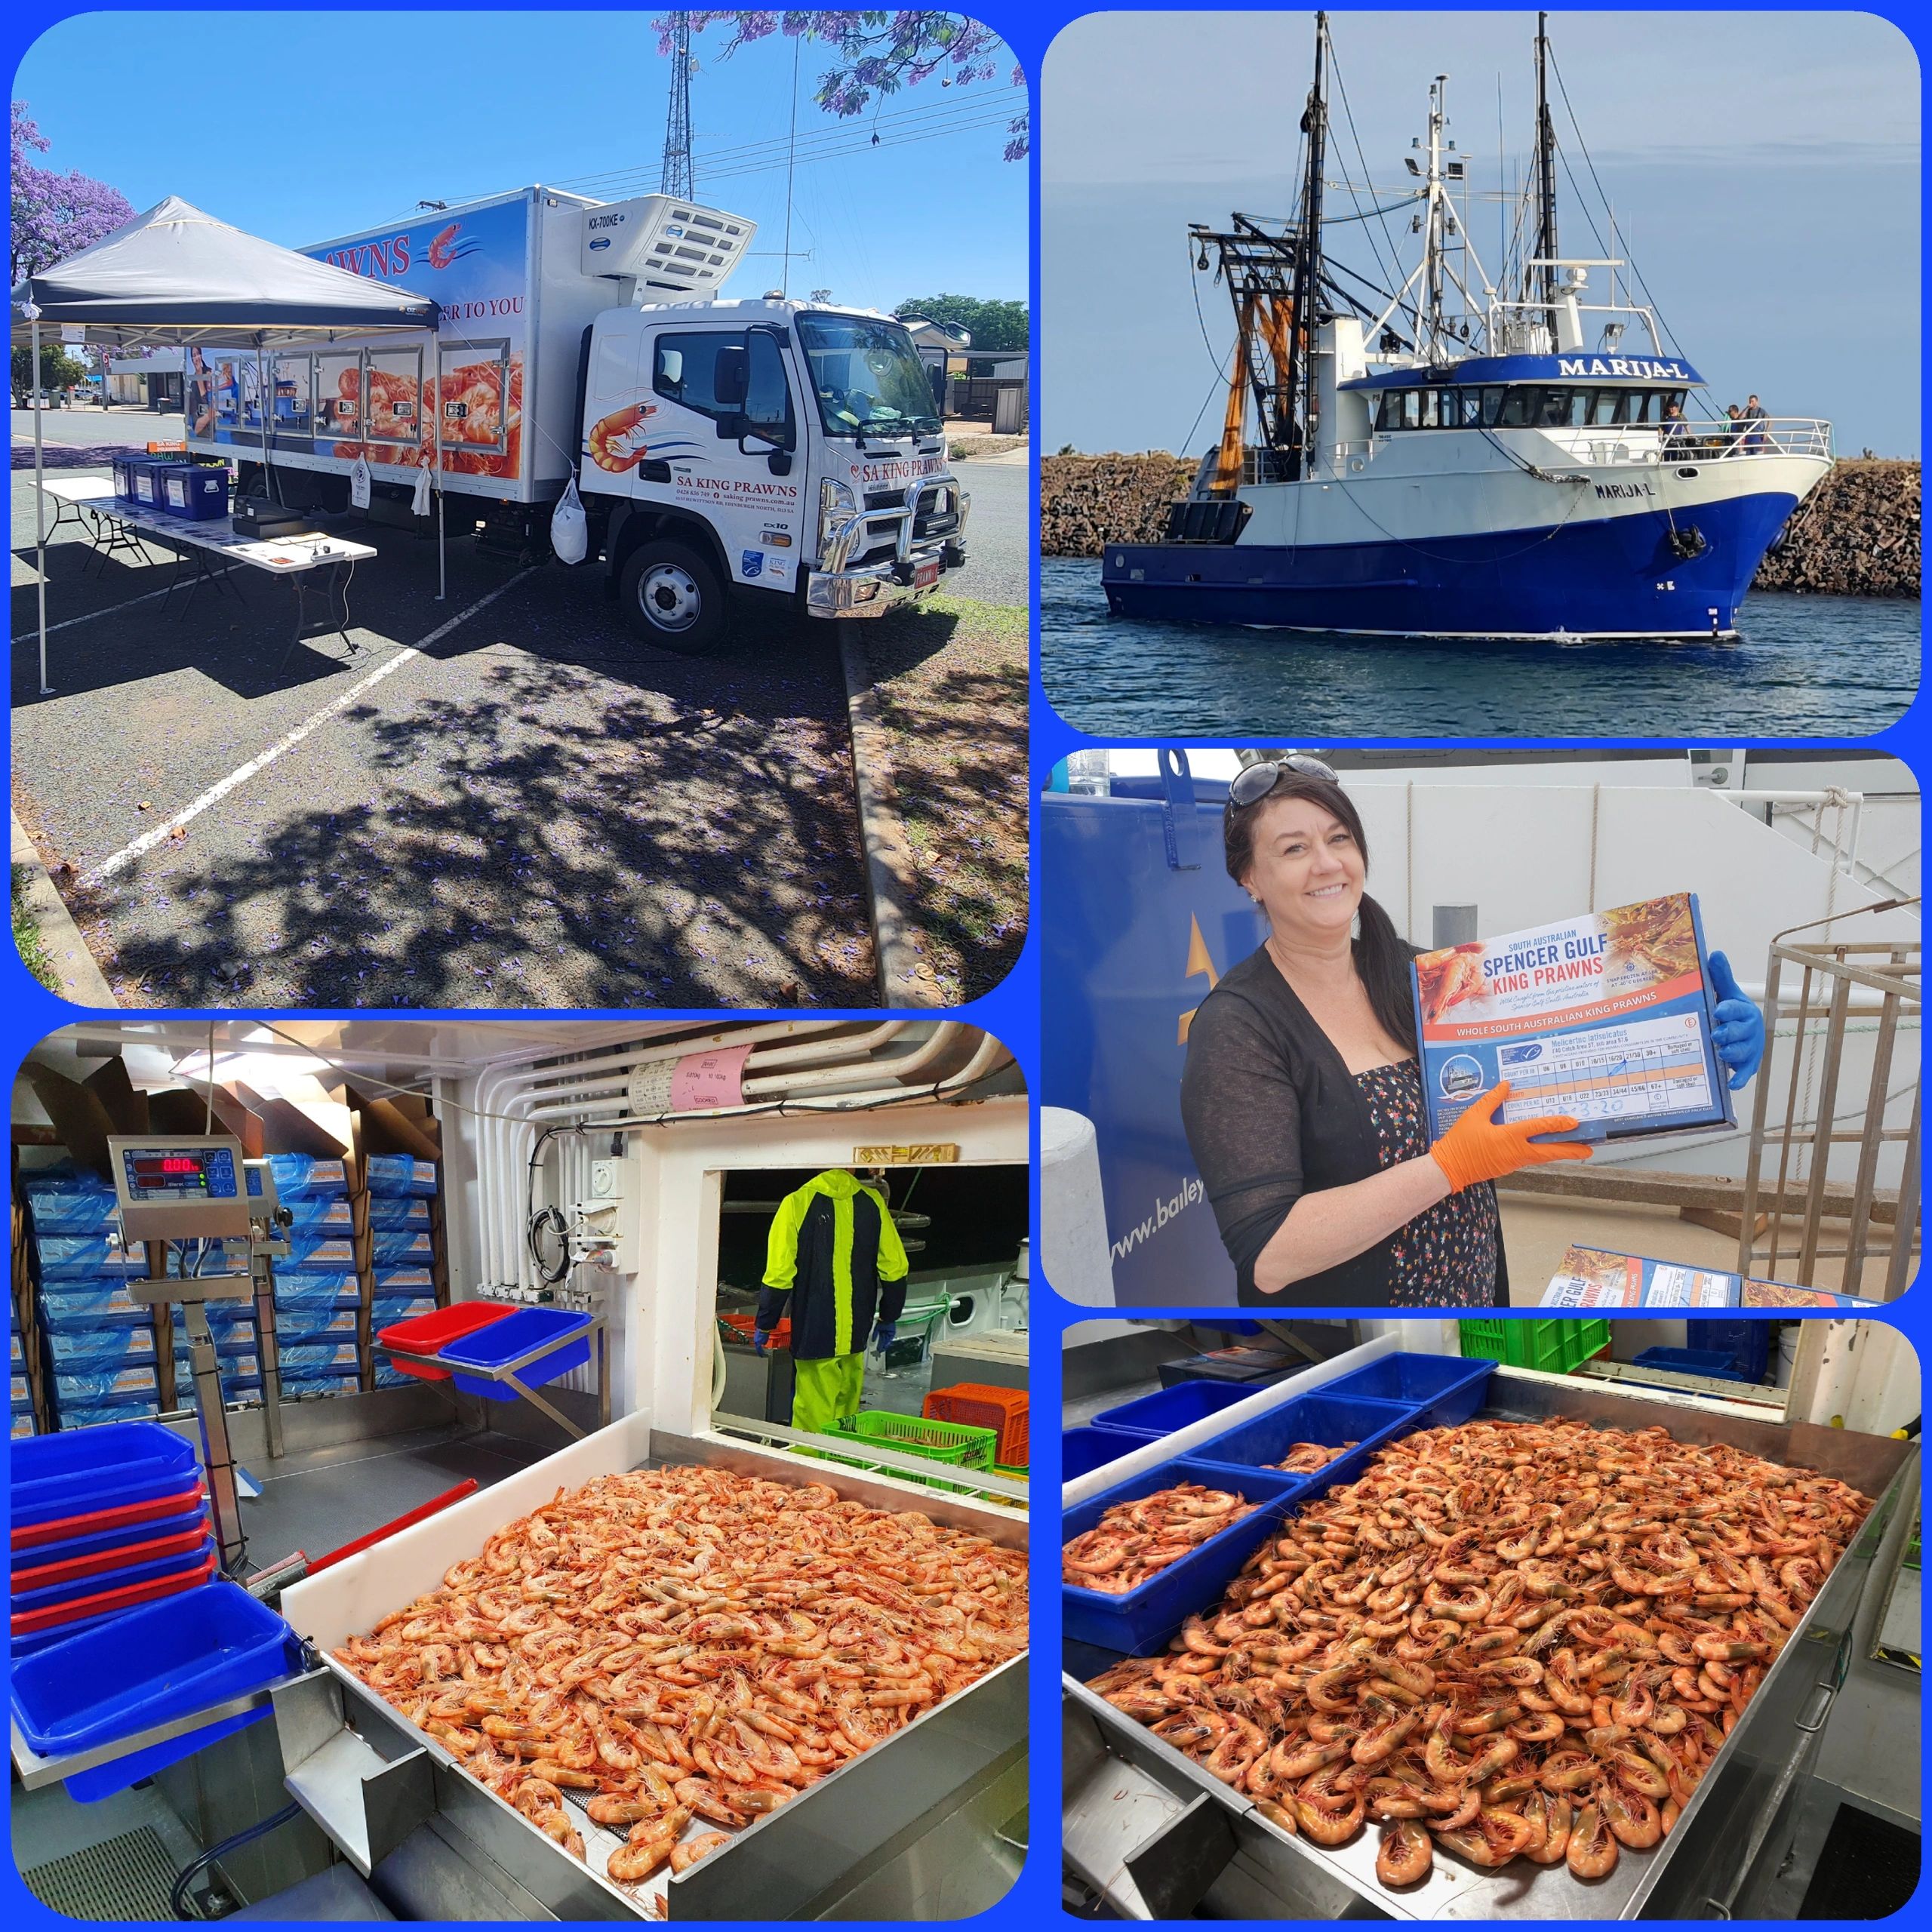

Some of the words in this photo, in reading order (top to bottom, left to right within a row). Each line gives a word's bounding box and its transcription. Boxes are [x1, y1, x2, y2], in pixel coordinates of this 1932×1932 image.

[589, 214, 618, 229] KX-700KE
[463, 302, 485, 318] TO
[489, 297, 524, 315] YOU
[1558, 358, 1688, 379] MARIJA-L
[863, 465, 879, 482] SA
[881, 461, 909, 480] KING
[911, 457, 943, 476] PRAWNS
[677, 475, 693, 487] SA
[696, 478, 730, 491] KING
[734, 481, 797, 497] PRAWNS
[1595, 483, 1656, 498] MARIJA-L
[724, 493, 743, 502] saking
[745, 496, 795, 506] prawns.com.au
[1509, 942, 1531, 952] SOUTH
[1534, 929, 1577, 948] AUSTRALIAN
[1483, 947, 1559, 977] SPENCER
[1564, 933, 1607, 959] GULF
[1493, 973, 1529, 995] KING
[1534, 956, 1604, 986] PRAWNS
[1457, 1026, 1488, 1037] WHOLE
[1491, 1022, 1521, 1034] SOUTH
[1524, 1012, 1583, 1029] AUSTRALIAN
[1586, 1004, 1611, 1018] KING
[1613, 992, 1657, 1011] PRAWNS
[164, 1159, 190, 1171] 0.00
[1566, 1276, 1586, 1296] GULF
